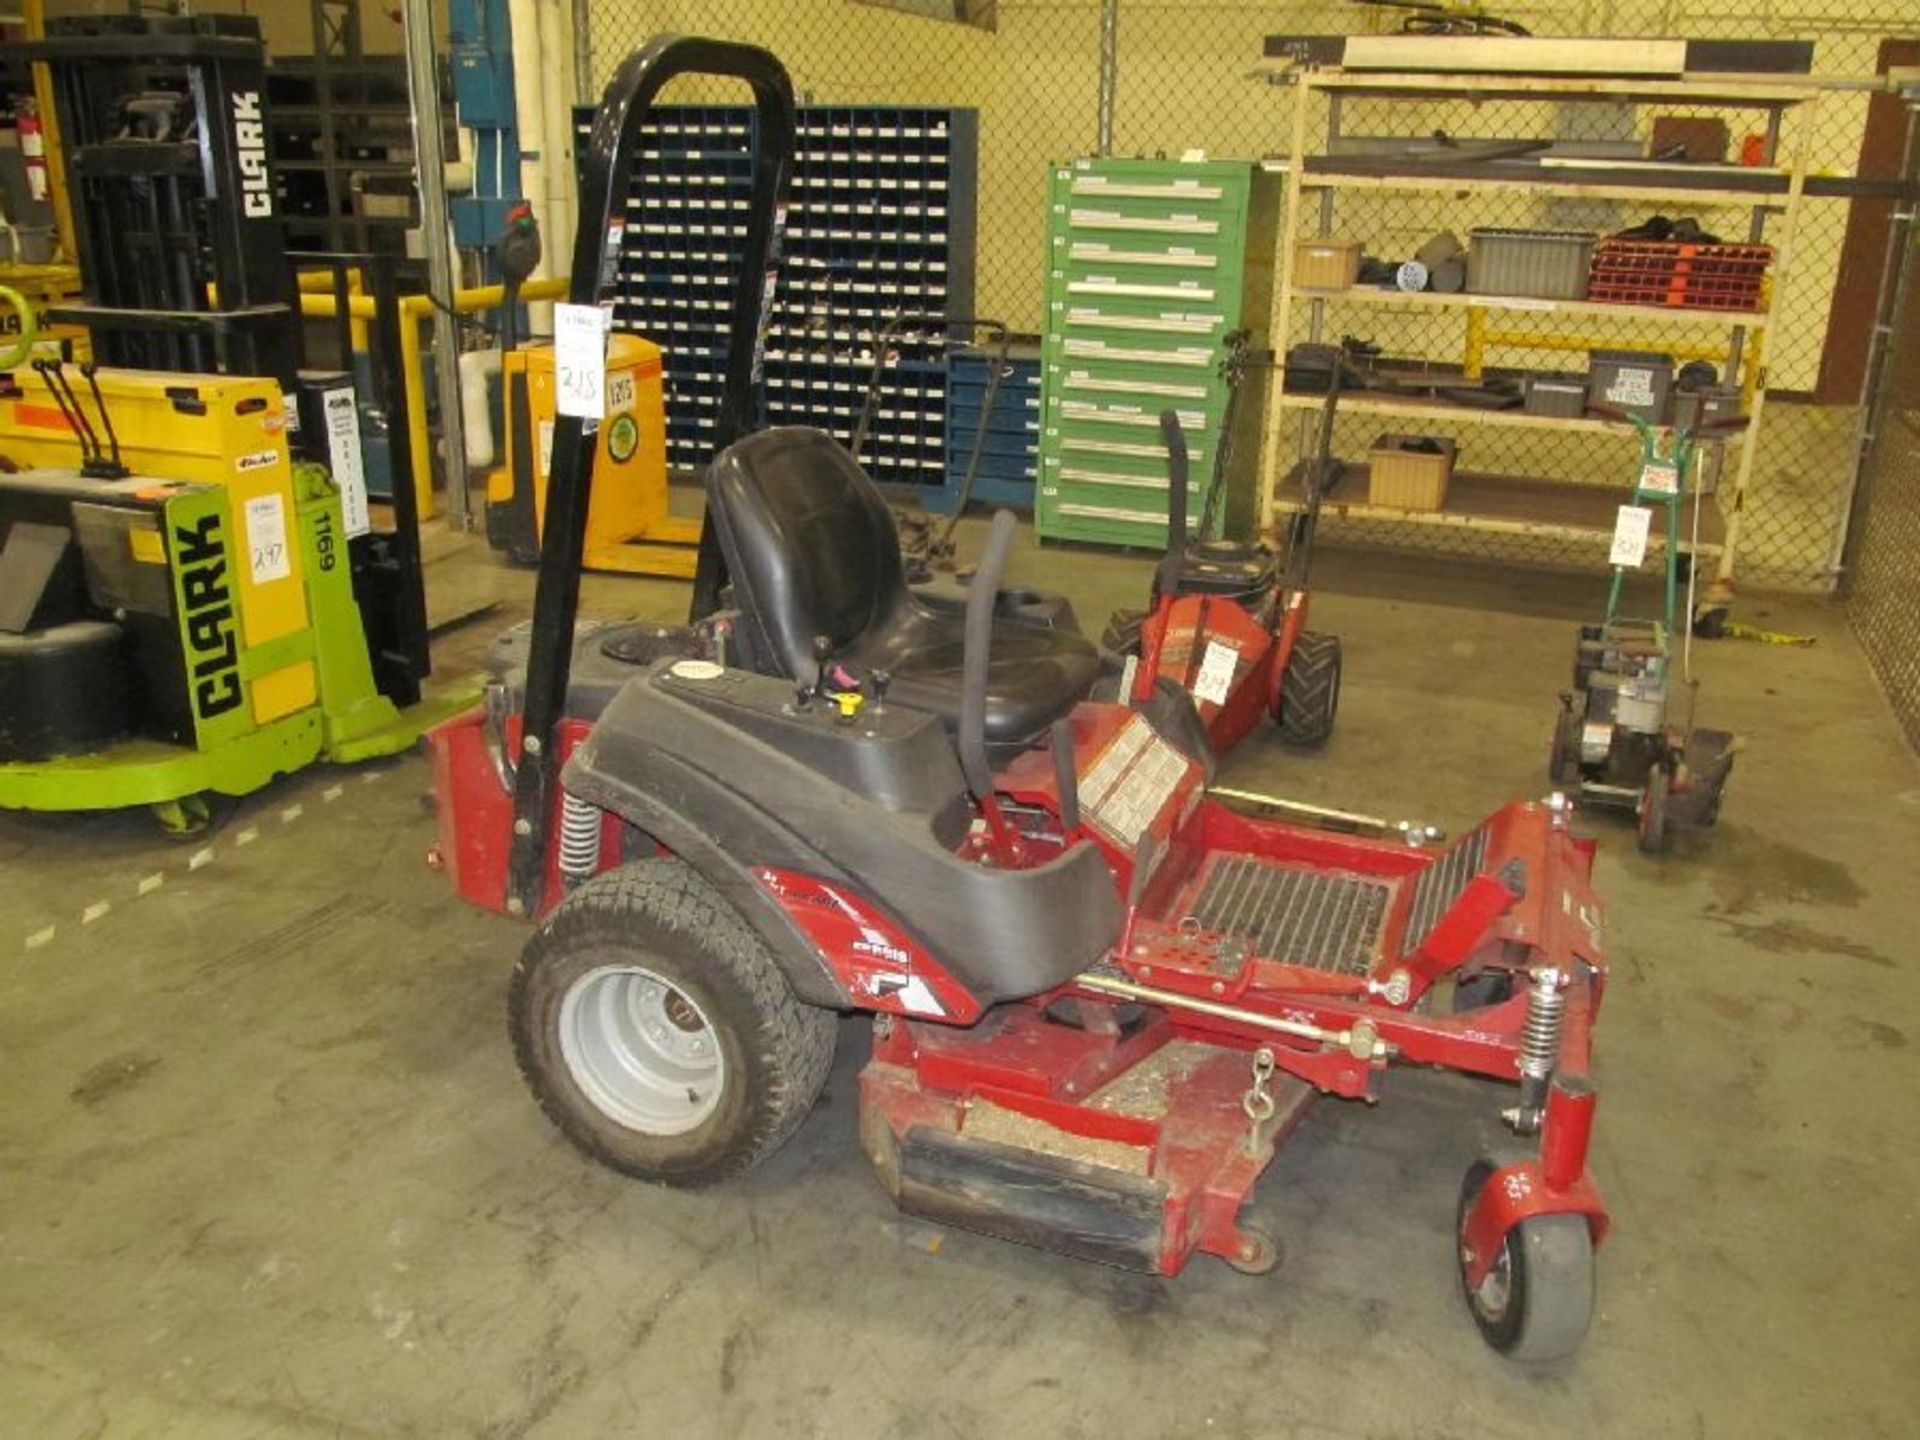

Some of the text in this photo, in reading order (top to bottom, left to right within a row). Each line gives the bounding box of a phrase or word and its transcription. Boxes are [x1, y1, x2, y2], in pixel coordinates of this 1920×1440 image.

[232, 91, 272, 218] CLARK
[314, 511, 336, 572] 1169
[176, 513, 243, 719] CLARK
